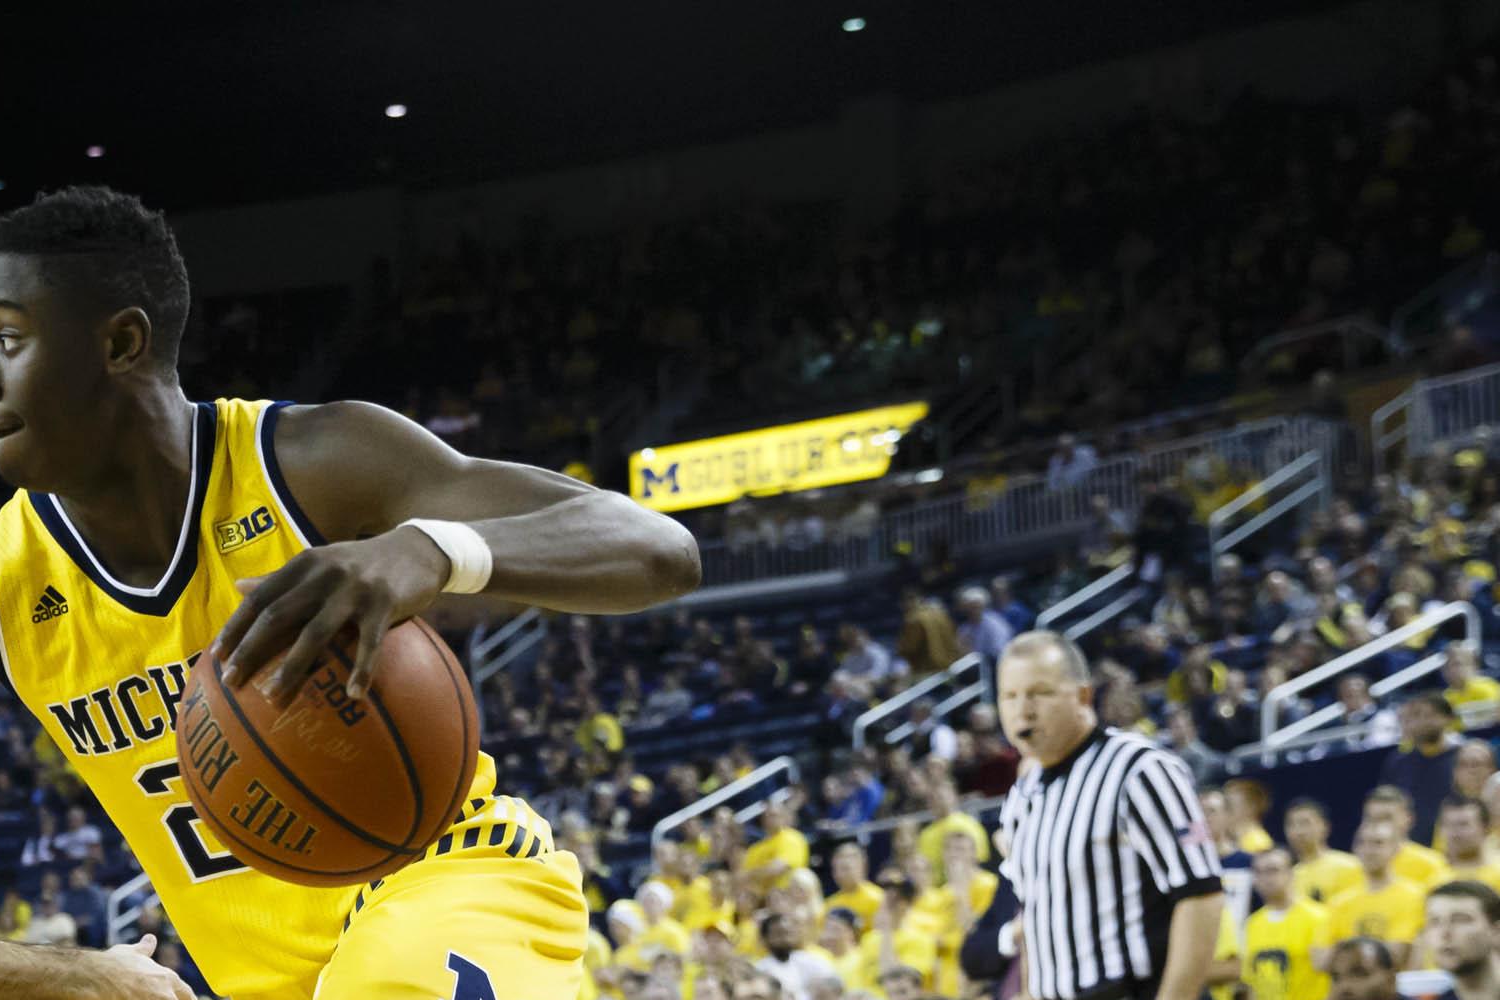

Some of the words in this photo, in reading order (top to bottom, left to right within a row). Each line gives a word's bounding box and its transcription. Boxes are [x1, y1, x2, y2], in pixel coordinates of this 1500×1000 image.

[641, 463, 681, 498] M
[48, 652, 203, 757] MICH
[184, 680, 240, 795] ROCK
[133, 757, 253, 885] 2
[229, 779, 319, 854] THE
